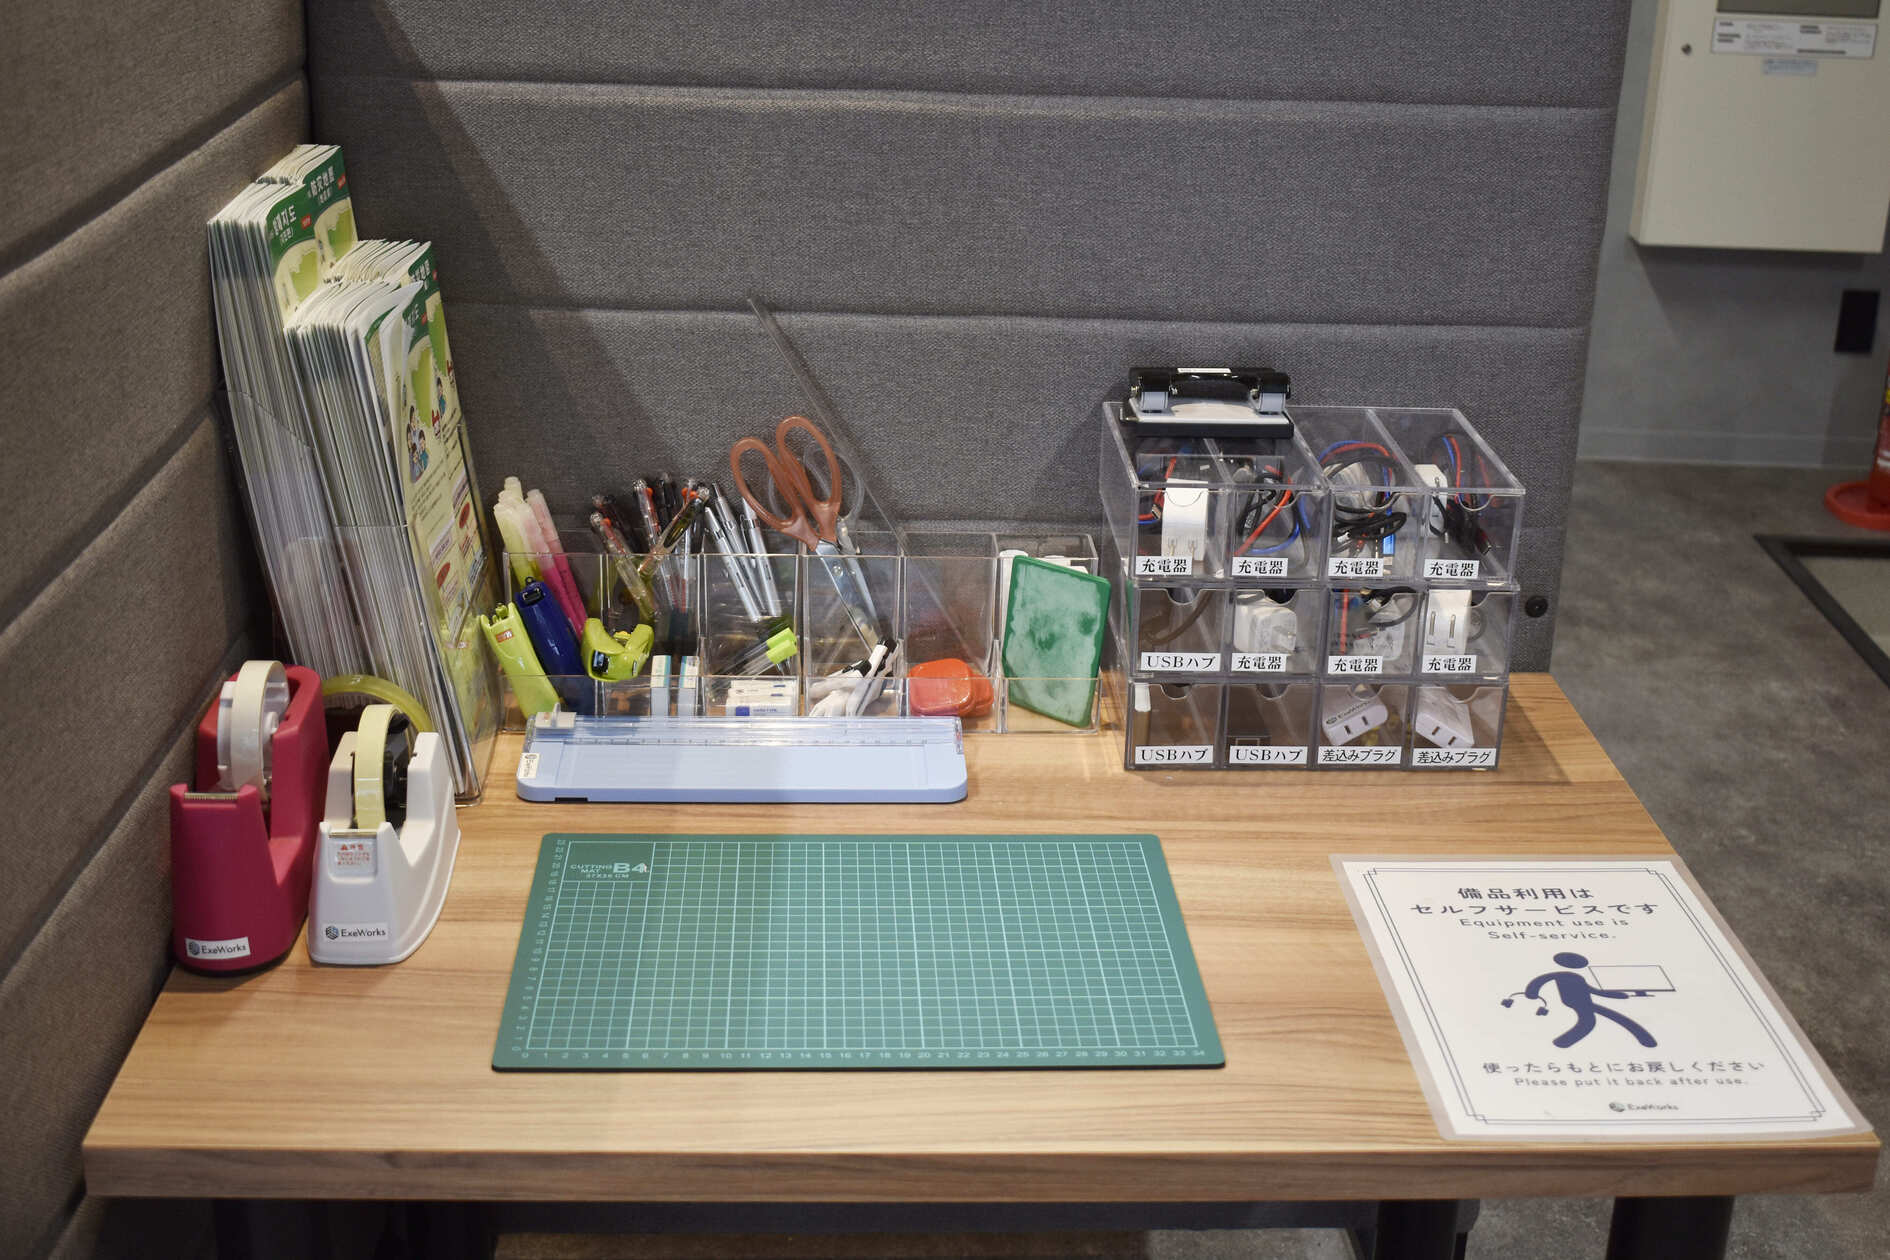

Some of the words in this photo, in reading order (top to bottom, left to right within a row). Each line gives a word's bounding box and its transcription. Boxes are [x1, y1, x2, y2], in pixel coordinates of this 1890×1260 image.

[1142, 558, 1187, 573] 充電器
[1239, 559, 1283, 575] 充電器
[1335, 559, 1379, 575] 充電器
[1430, 562, 1474, 577] 充電器
[1238, 656, 1282, 670] 充電器
[1334, 658, 1378, 673] 充電器
[1428, 657, 1472, 671] 充電器
[1322, 749, 1396, 762] 差込みプラグ
[1417, 751, 1492, 764] 差込みプラグ
[612, 861, 645, 874] B4
[1457, 887, 1594, 900] 備品利用は
[1410, 903, 1658, 916] セルフサービスです
[1459, 918, 1564, 929] Equipment
[1611, 918, 1629, 926] is
[340, 928, 386, 938] ExeWorks
[1487, 931, 1617, 940] Self-service.
[201, 944, 247, 955] ExeWorks
[1482, 1061, 1765, 1074] 使ったらもとにお戻しください
[1514, 1077, 1568, 1086] Please
[1574, 1078, 1601, 1088] put
[1607, 1078, 1619, 1086] it
[1624, 1077, 1663, 1086] back
[1669, 1076, 1709, 1086] after
